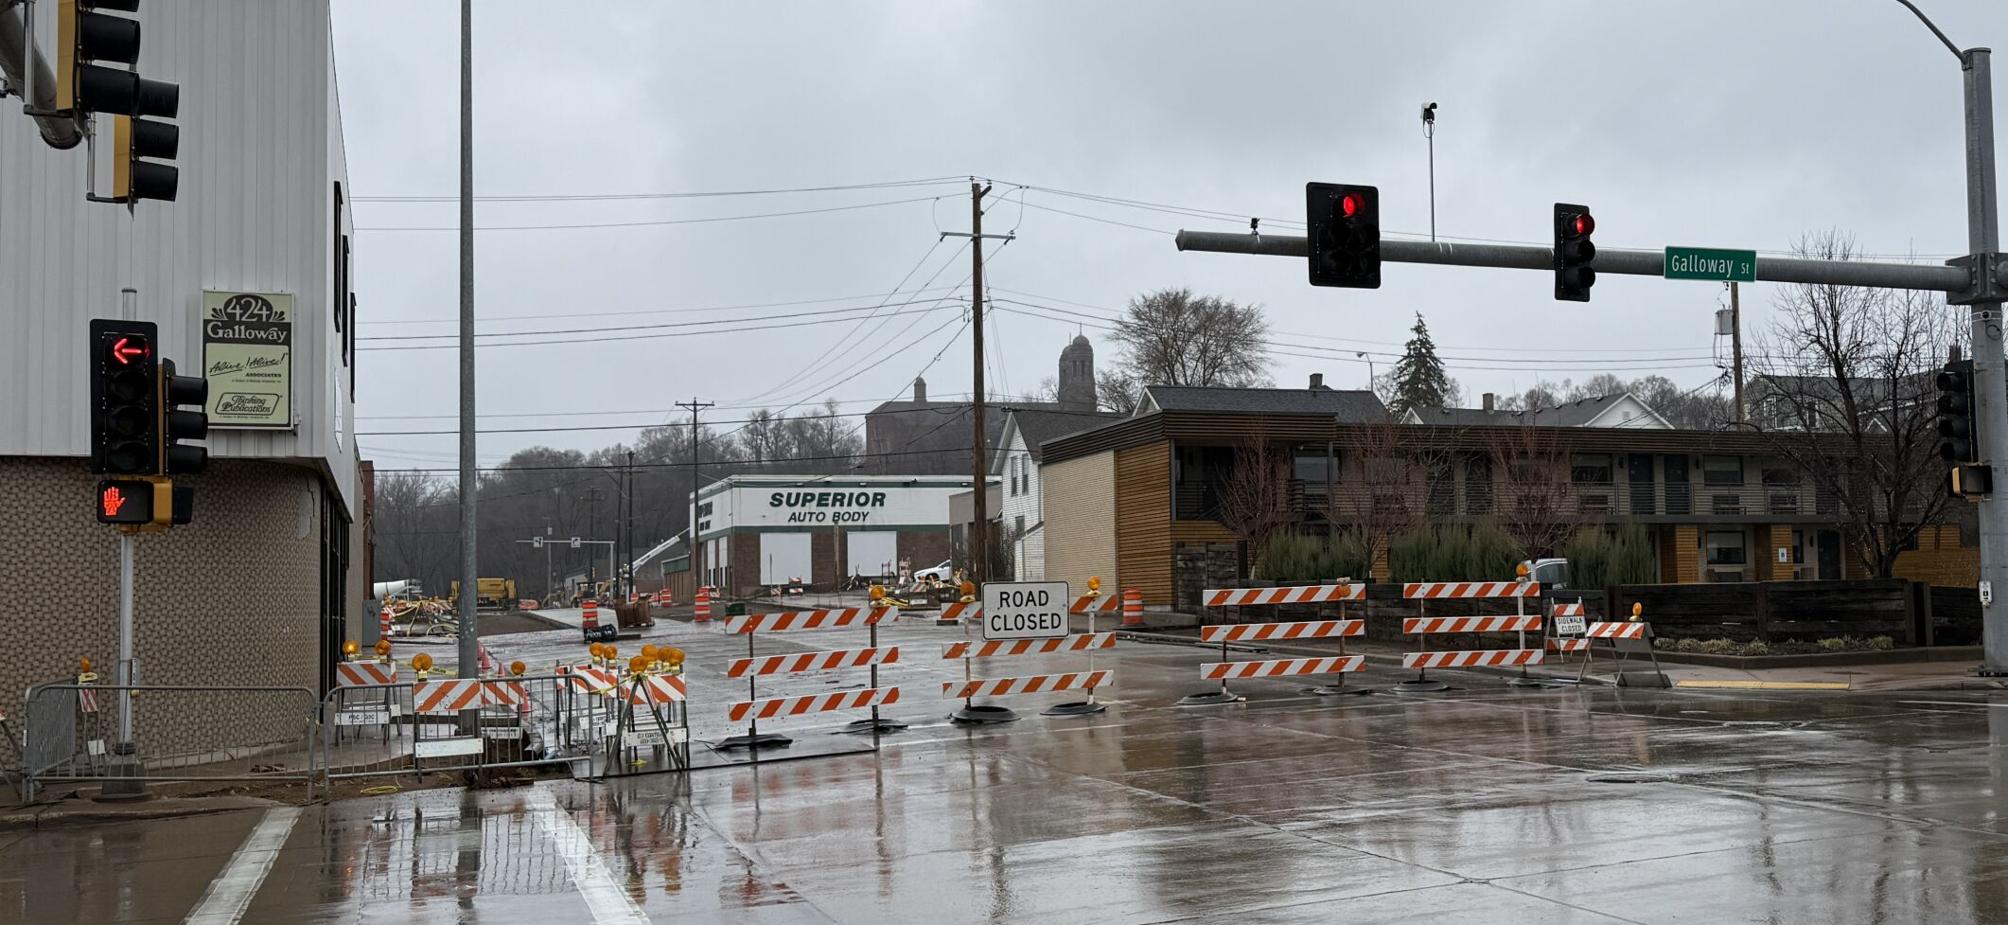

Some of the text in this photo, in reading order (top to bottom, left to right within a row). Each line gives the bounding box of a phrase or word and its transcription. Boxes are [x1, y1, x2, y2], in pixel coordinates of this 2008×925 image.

[1672, 255, 1749, 278] Galloway St
[226, 297, 270, 321] 424
[207, 321, 287, 342] Galloway
[769, 491, 887, 508] SUPERIOR
[788, 511, 870, 523] AUTO BODY
[999, 590, 1049, 608] ROAD
[990, 613, 1062, 632] CLOSED
